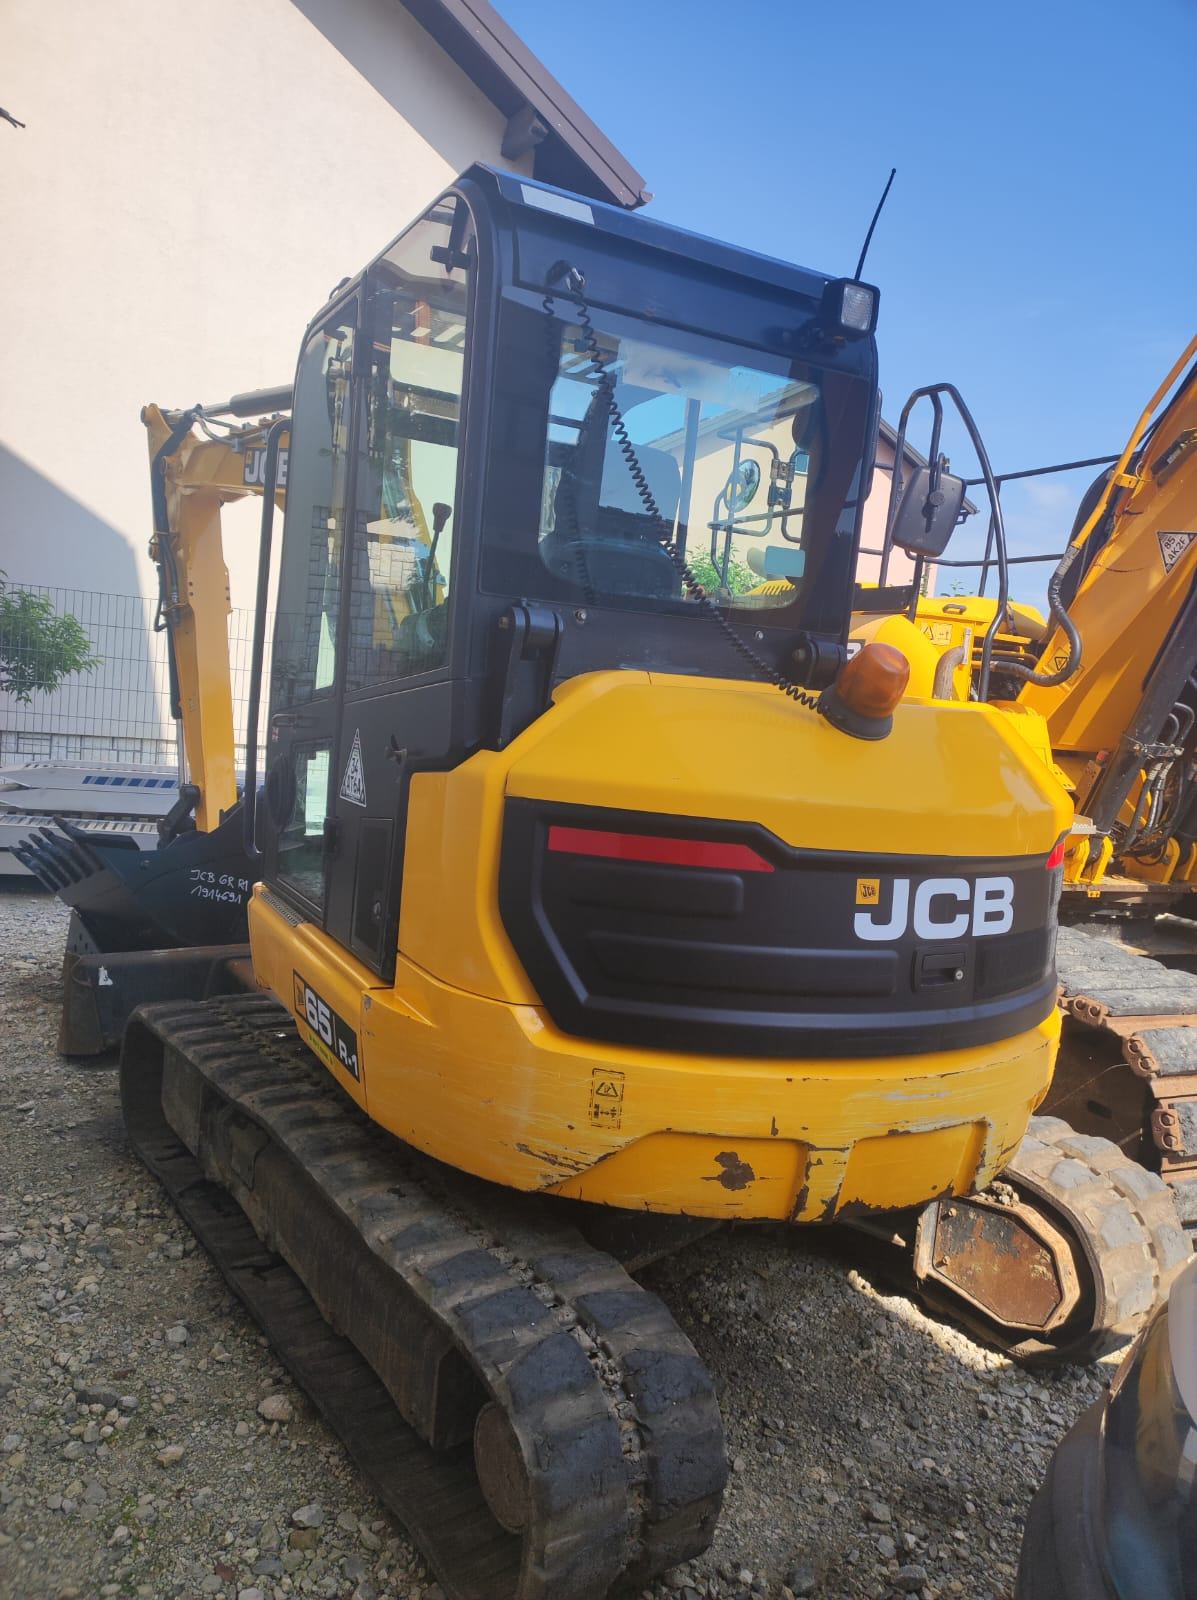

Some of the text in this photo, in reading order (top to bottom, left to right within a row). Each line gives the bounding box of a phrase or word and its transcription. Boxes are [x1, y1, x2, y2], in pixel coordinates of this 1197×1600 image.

[189, 869, 216, 883] JCB
[854, 877, 1014, 941] JCB
[305, 987, 333, 1047] 65
